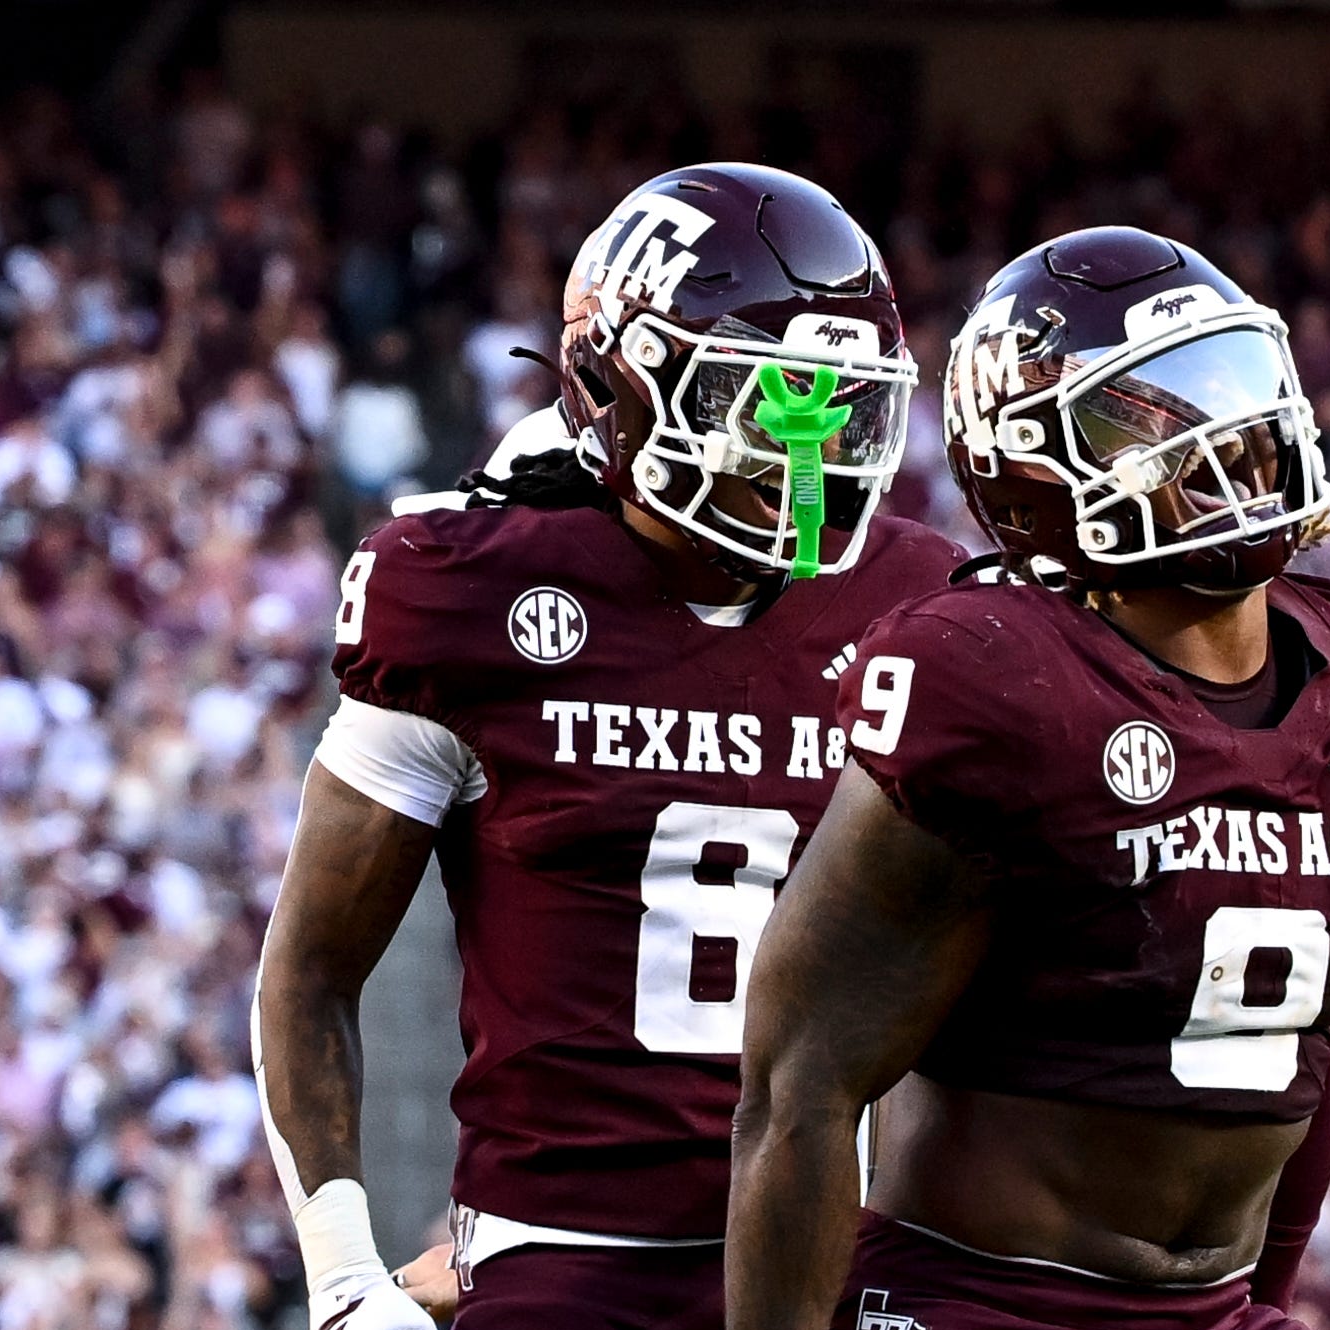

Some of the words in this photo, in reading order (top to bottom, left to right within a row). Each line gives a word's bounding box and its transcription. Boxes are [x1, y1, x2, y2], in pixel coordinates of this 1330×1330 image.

[335, 551, 376, 644] 8
[510, 588, 585, 662] SEC
[542, 700, 762, 776] TEXAS
[786, 715, 847, 780] A&
[850, 656, 915, 755] 9
[1105, 722, 1174, 804] SEC
[1116, 805, 1288, 887] TEXAS
